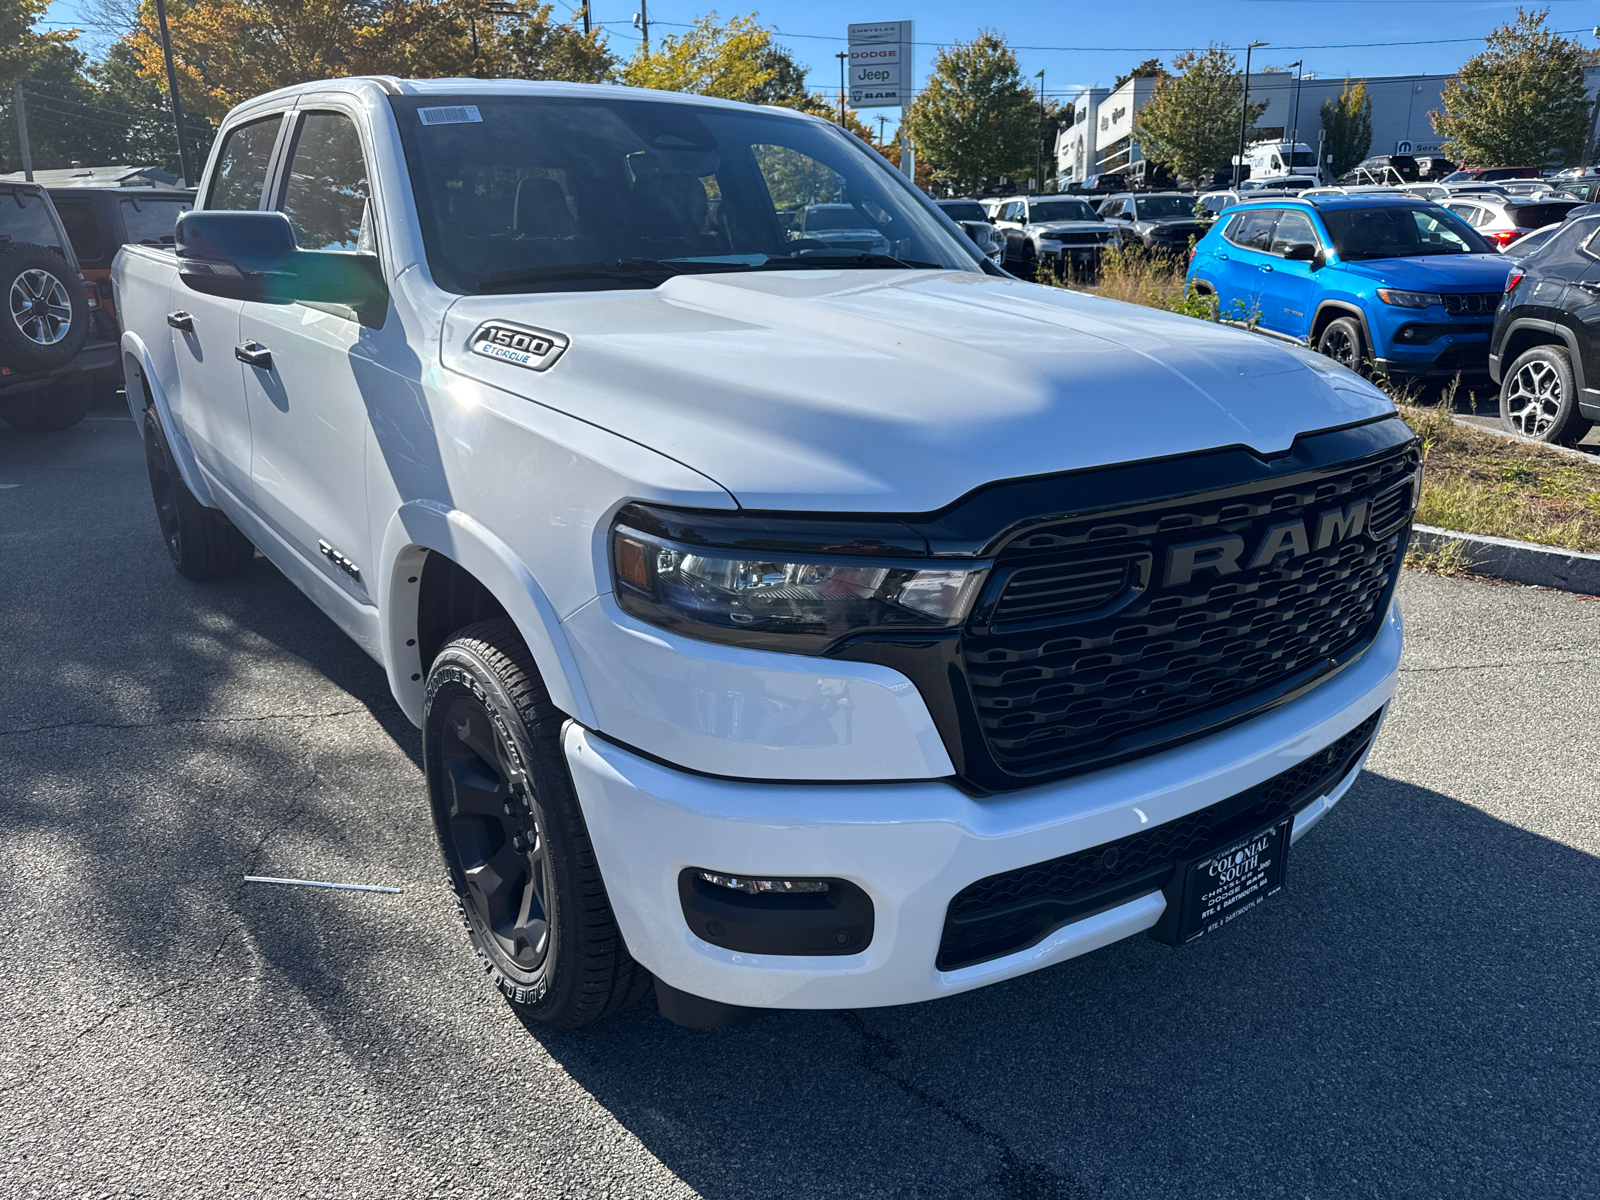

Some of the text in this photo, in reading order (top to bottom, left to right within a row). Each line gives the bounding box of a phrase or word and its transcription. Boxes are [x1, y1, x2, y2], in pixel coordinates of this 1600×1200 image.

[851, 50, 897, 59] DODGE
[858, 68, 890, 82] Jeep
[864, 91, 897, 99] RAM
[487, 328, 550, 355] 1500
[1161, 497, 1369, 588] RAM
[1208, 836, 1269, 877] COLONIAL
[1219, 853, 1259, 886] SOUTH
[1201, 859, 1271, 901] CHRYSLER Jeep
[1208, 871, 1265, 907] DODGE RAM
